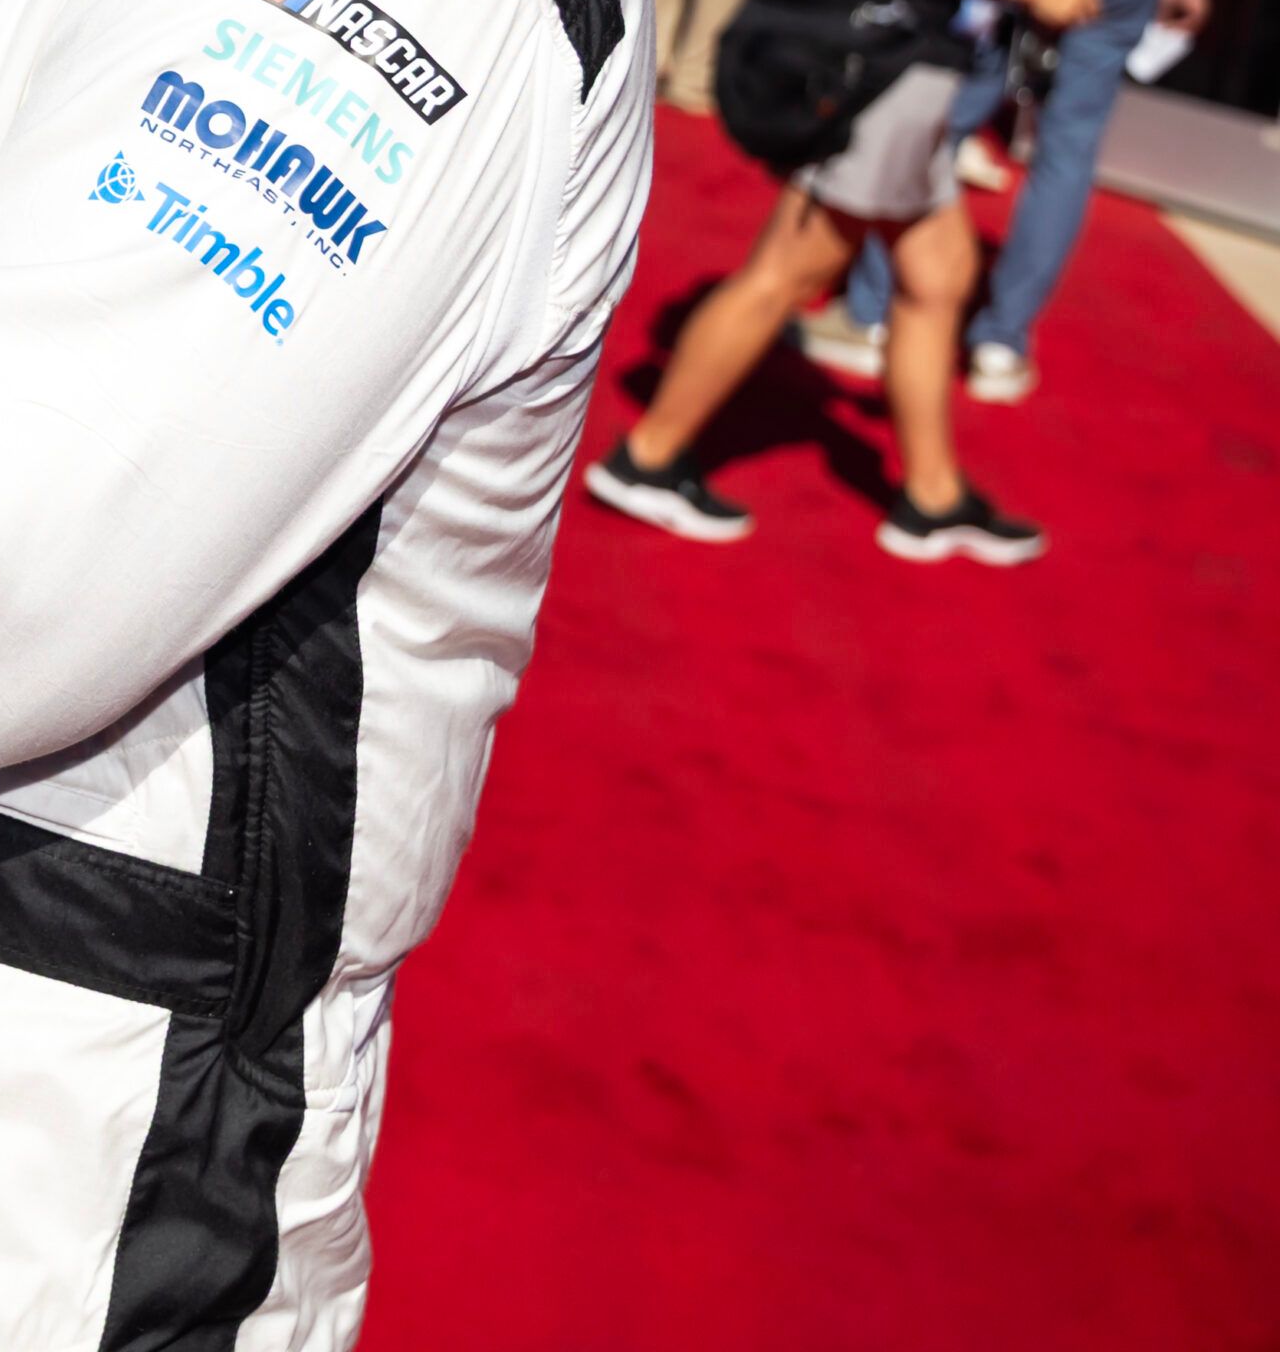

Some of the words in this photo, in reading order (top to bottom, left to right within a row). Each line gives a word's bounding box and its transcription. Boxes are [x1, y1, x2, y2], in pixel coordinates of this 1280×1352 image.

[140, 70, 388, 265] MOHAWK
[202, 19, 415, 185] SIEMENS
[140, 118, 299, 227] NORTHEAST,
[306, 229, 346, 277] INC.
[146, 181, 296, 337] Trimble
